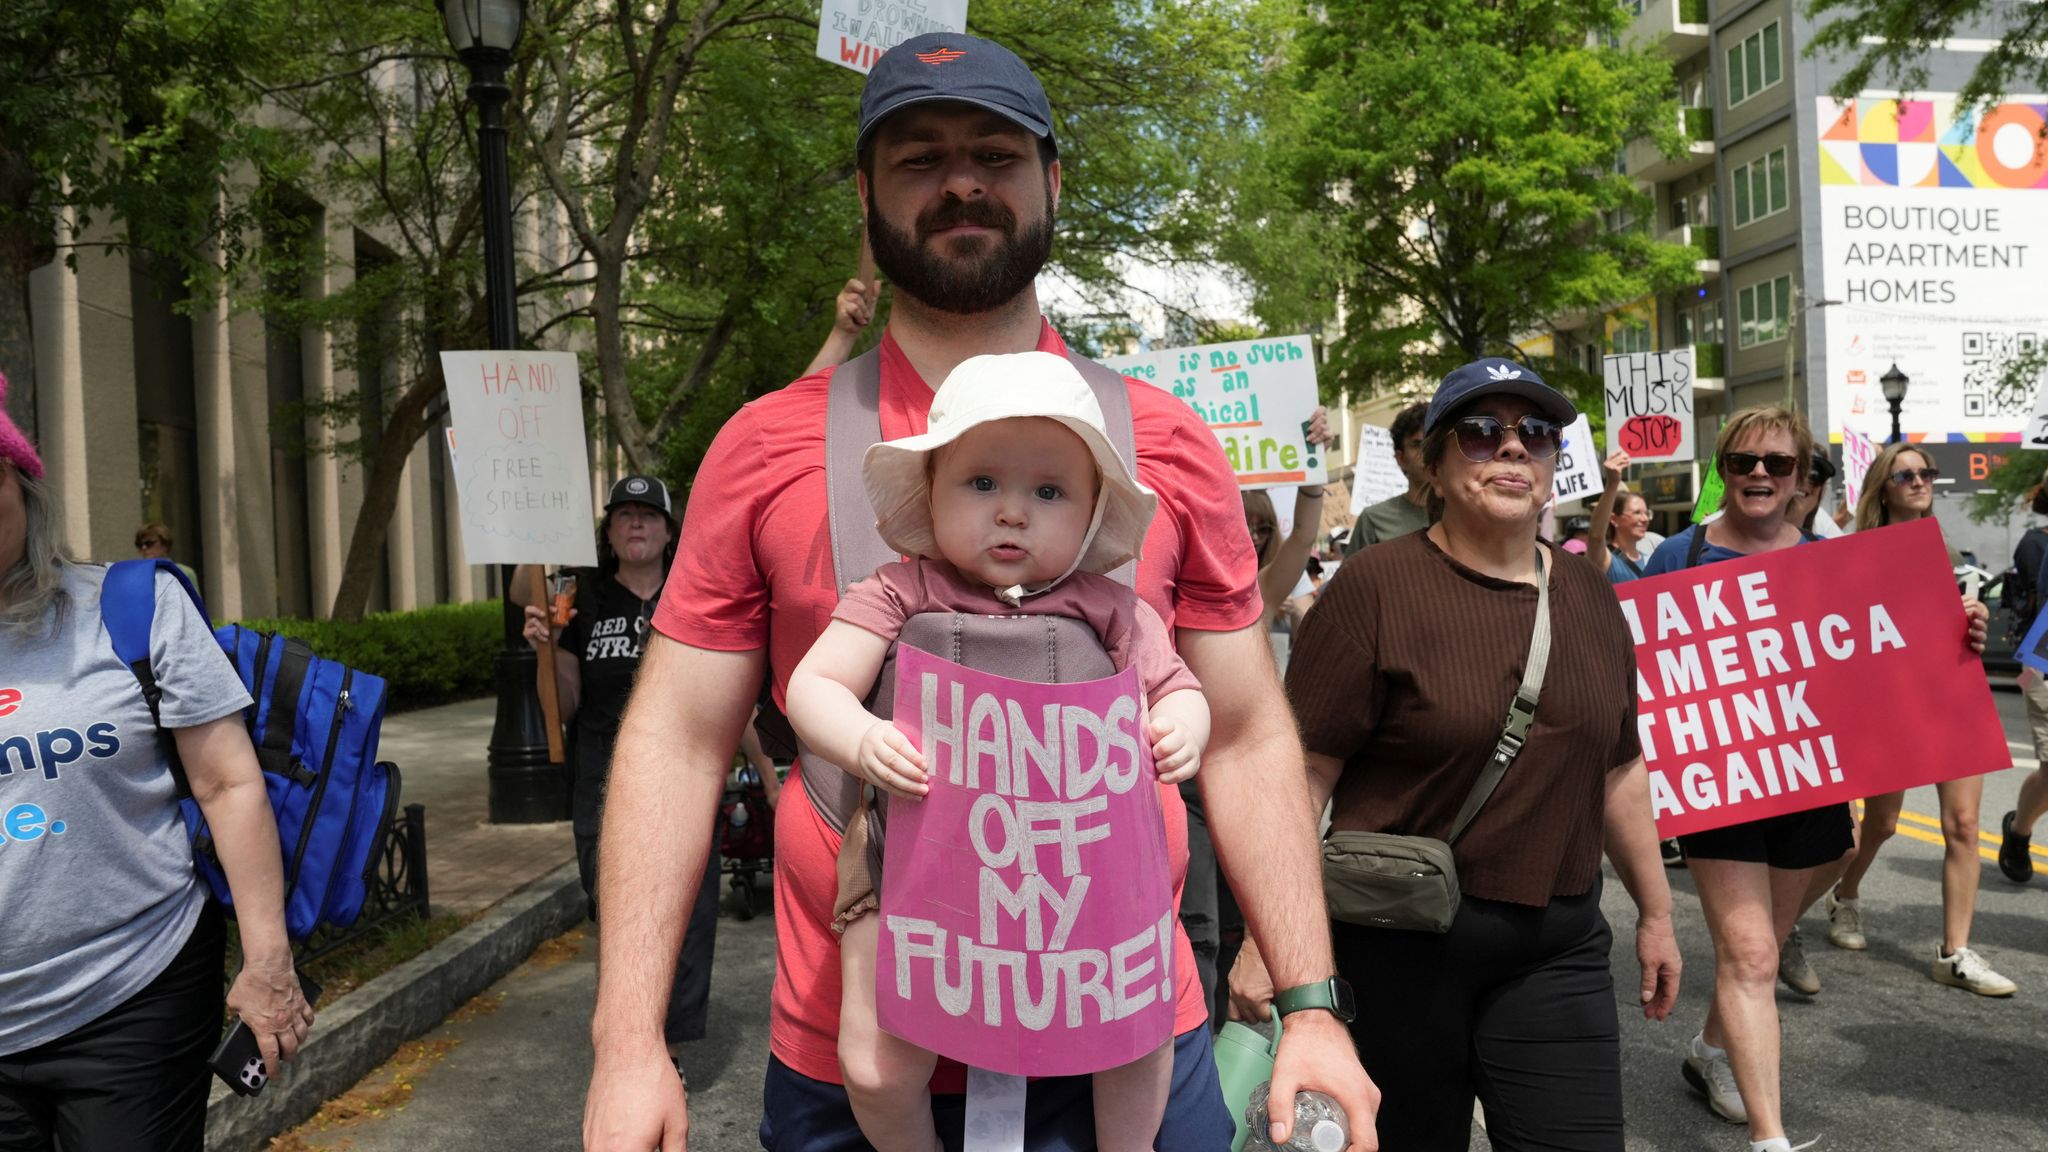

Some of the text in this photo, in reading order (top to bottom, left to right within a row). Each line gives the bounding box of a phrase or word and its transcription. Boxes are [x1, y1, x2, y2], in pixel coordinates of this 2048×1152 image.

[832, 11, 862, 38] IN
[1845, 205, 2001, 236] BOUTIQUE
[1844, 242, 2028, 268] APARTMENT
[1847, 279, 1956, 303] HOMES
[1179, 352, 1201, 373] is
[1209, 350, 1238, 368] no
[1604, 351, 1690, 386] THIS
[481, 362, 561, 396] HANDS
[1173, 371, 1249, 398] as an
[1606, 381, 1692, 418] MUSK
[498, 404, 548, 441] OFF
[1627, 416, 1678, 451] STOP!
[492, 456, 544, 482] FREE
[1969, 452, 1989, 481] B
[1556, 472, 1588, 497] LIFE
[486, 489, 570, 516] SPEECH!
[591, 616, 628, 638] RED
[921, 671, 1140, 800] HANDS
[1638, 680, 1821, 762] THINK
[1648, 734, 1845, 820] AGAIN!
[0, 802, 67, 847] e.
[968, 793, 1111, 877] OFF
[979, 866, 1092, 951] MY
[886, 908, 1173, 1031] FUTURE!
